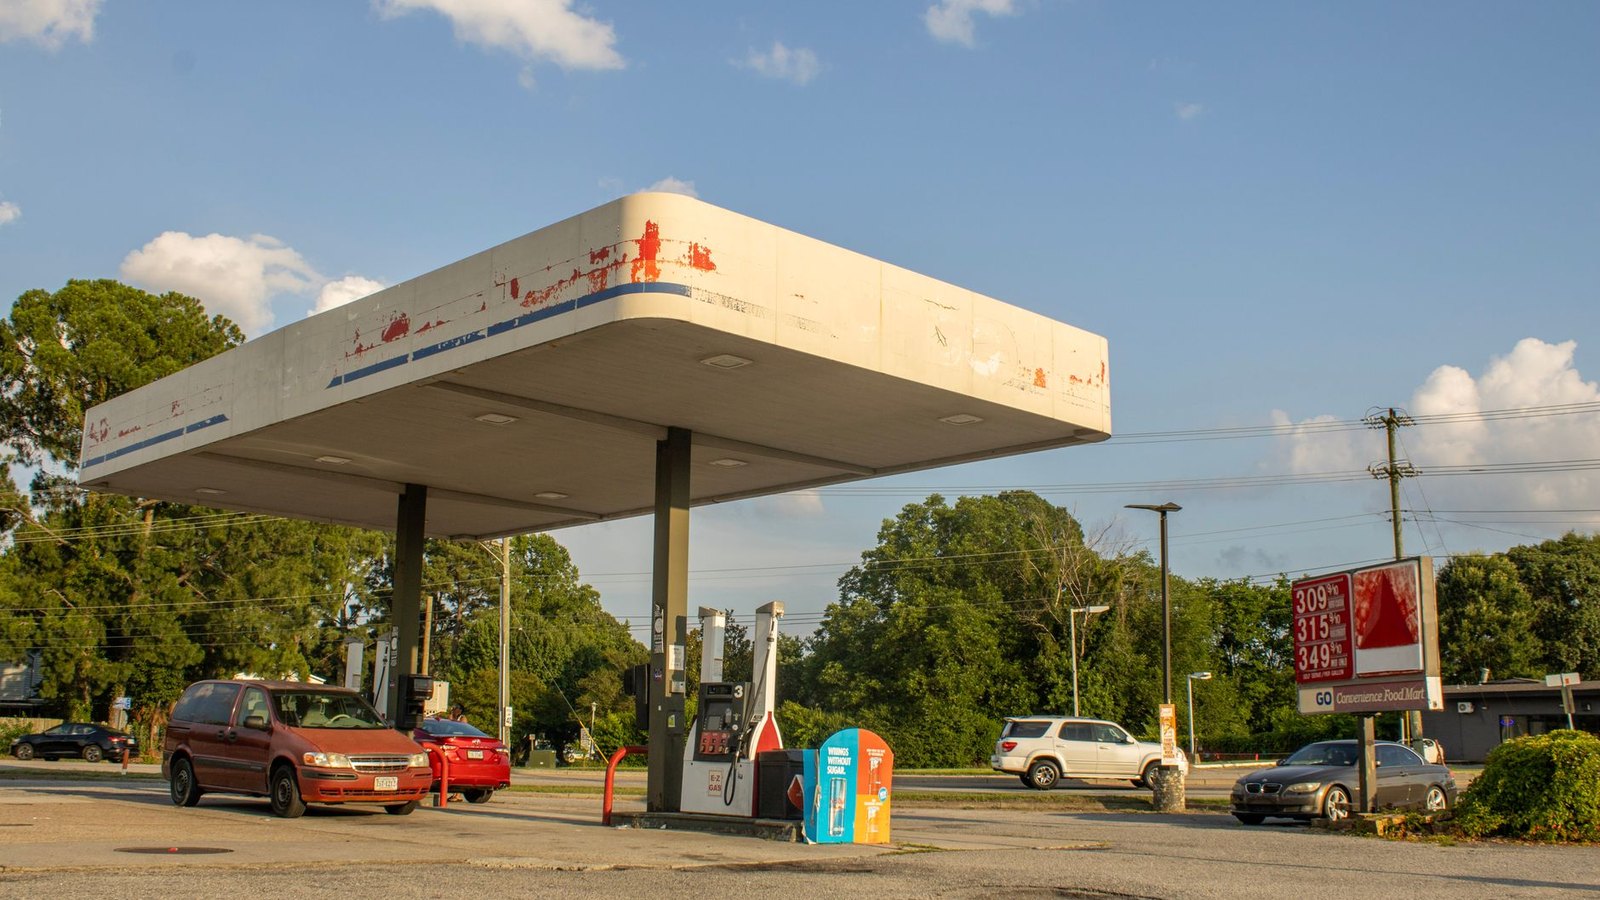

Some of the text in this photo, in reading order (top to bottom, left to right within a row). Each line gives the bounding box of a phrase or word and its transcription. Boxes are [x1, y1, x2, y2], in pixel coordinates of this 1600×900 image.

[1296, 585, 1327, 614] 309
[1298, 614, 1329, 641] 315
[1299, 643, 1330, 671] 349
[734, 685, 743, 698] 3
[1316, 687, 1425, 705] GO Convenience Food Mart
[827, 746, 849, 756] WINGS
[827, 756, 852, 766] WITHOUT
